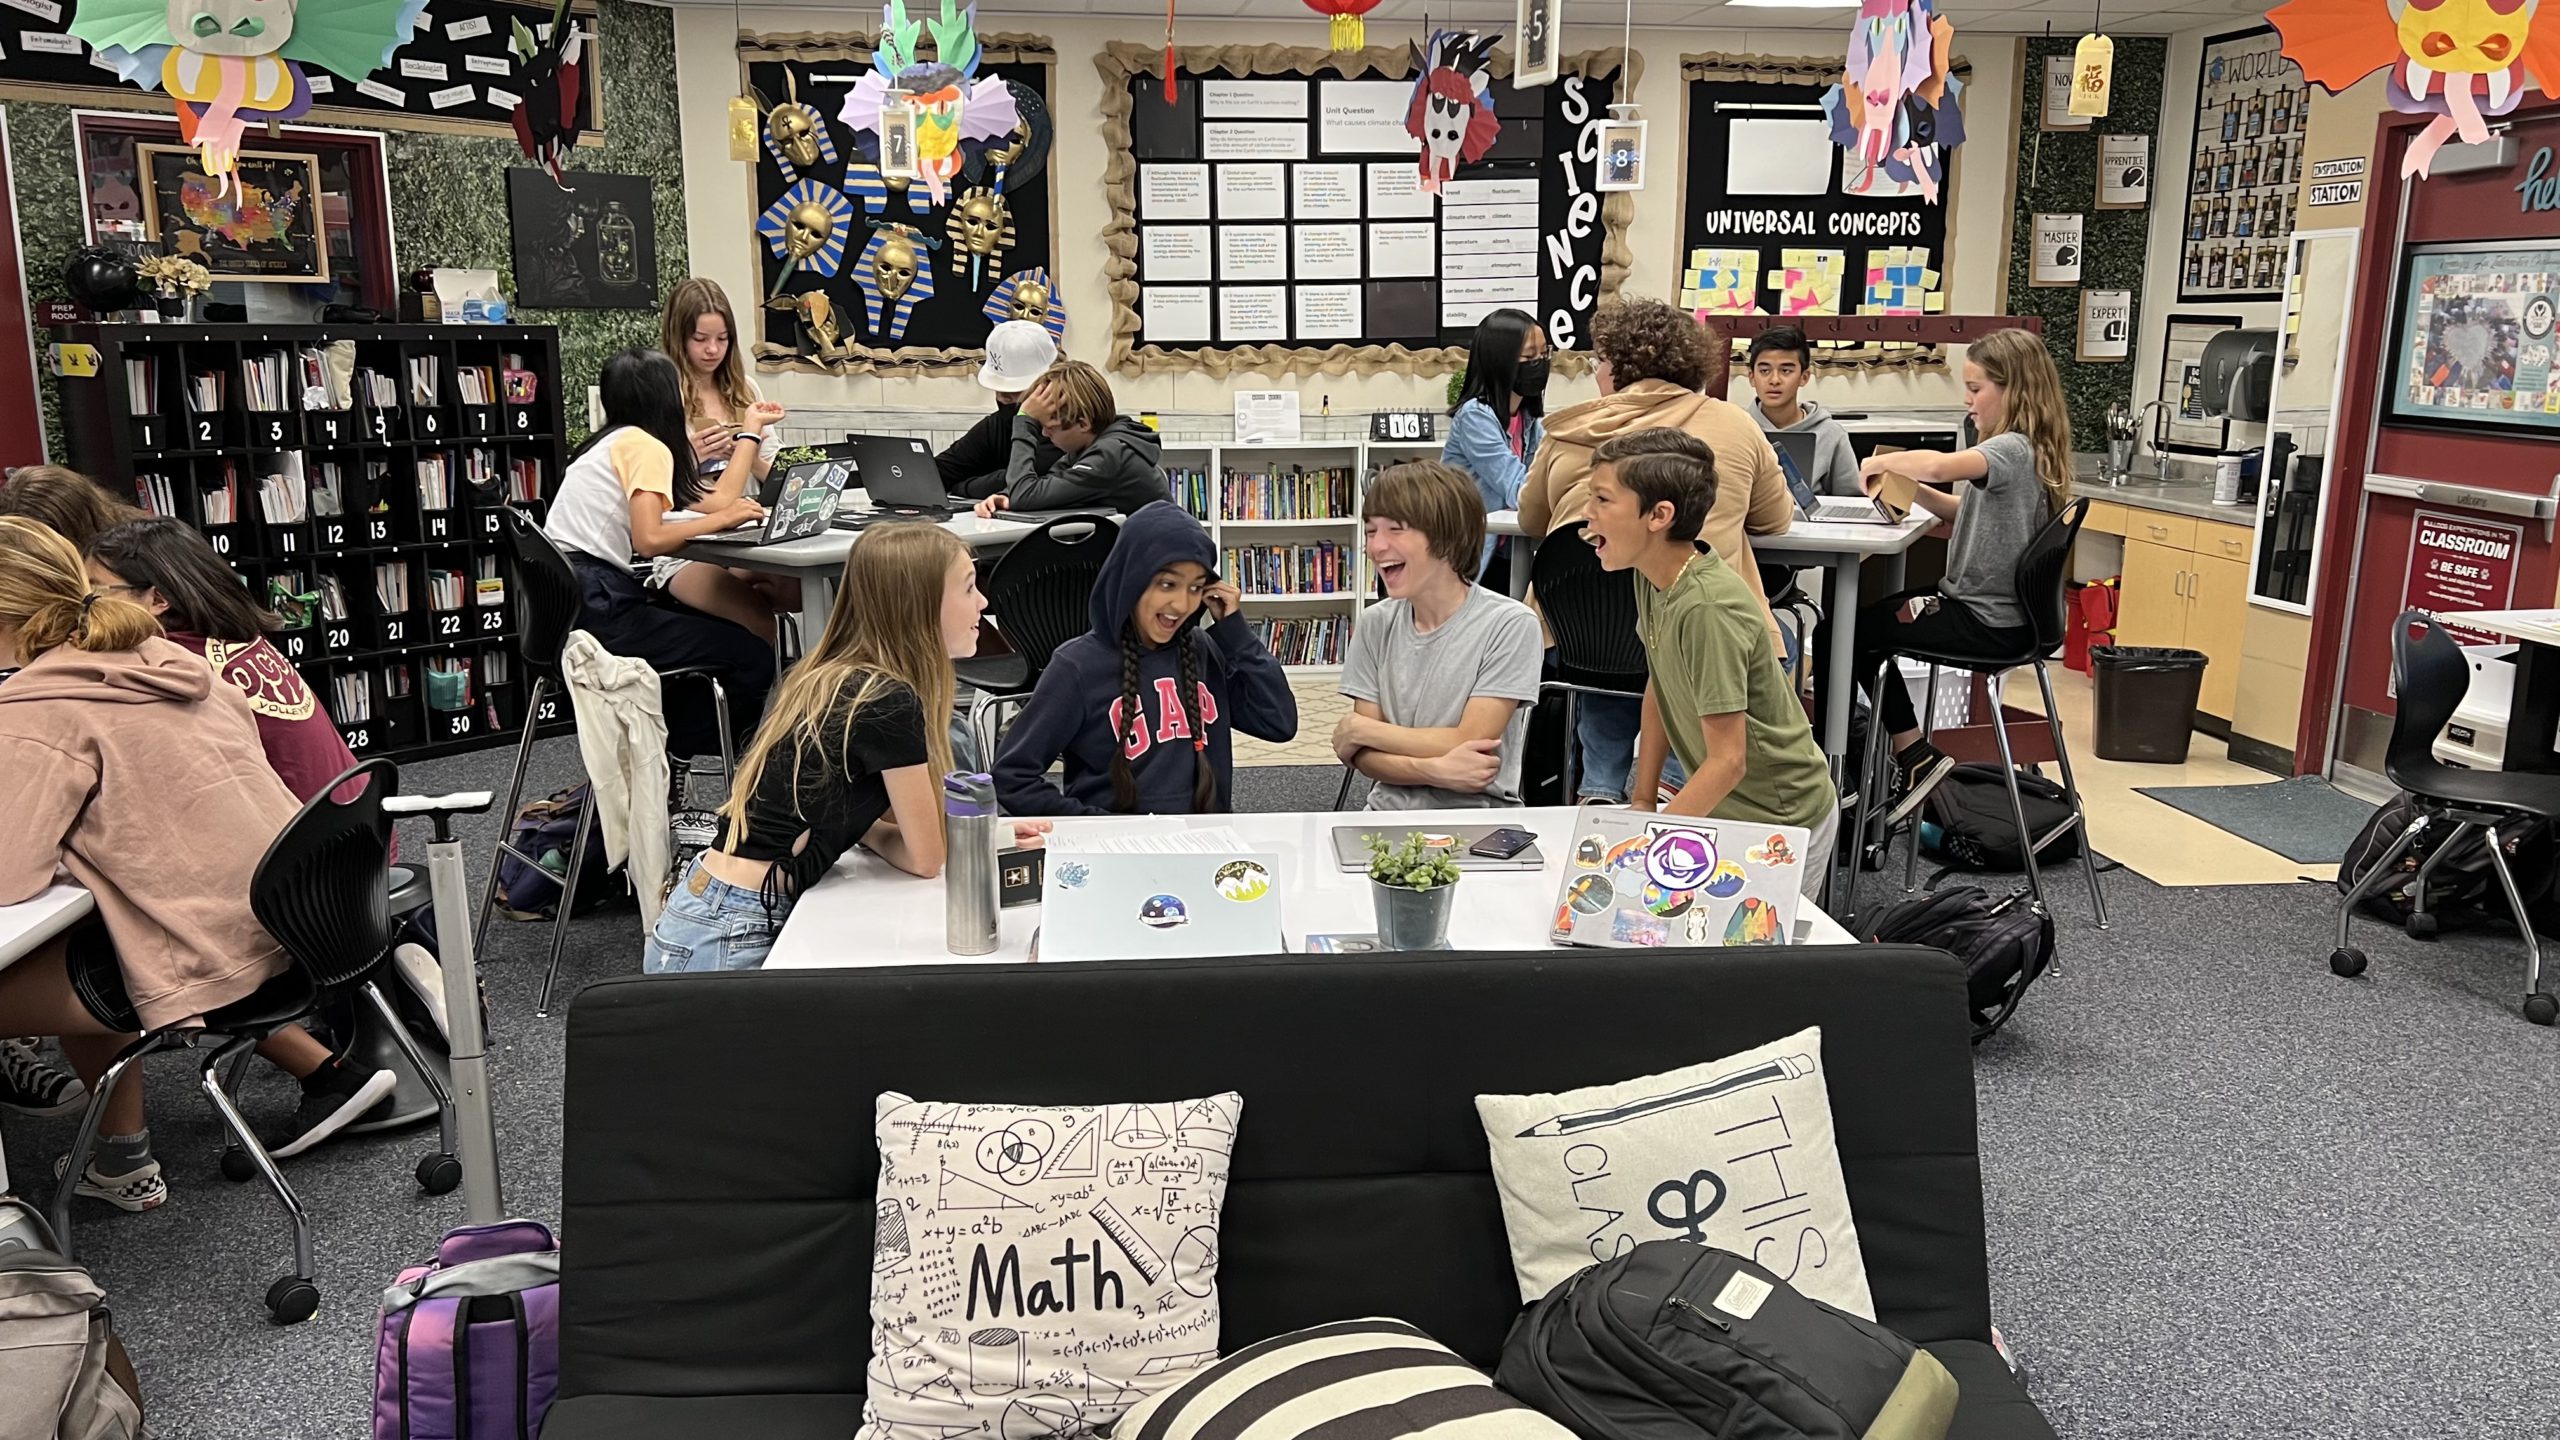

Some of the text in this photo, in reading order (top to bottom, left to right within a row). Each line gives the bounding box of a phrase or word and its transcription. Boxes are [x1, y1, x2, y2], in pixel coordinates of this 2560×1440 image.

[1533, 10, 1543, 41] 5
[893, 135, 903, 153] 7
[1616, 149, 1628, 168] 8
[2104, 155, 2144, 166] APPRENTICE
[2314, 160, 2363, 176] INSPIRATION
[2128, 166, 2145, 188] 2
[2311, 184, 2360, 203] STATION
[2044, 231, 2078, 243] MASTER
[2066, 245, 2078, 266] 3
[51, 304, 75, 312] PREP
[51, 312, 77, 320] ROOM
[2092, 307, 2127, 319] EXPERT!
[2111, 320, 2125, 342] 4
[427, 414, 437, 432] 6
[517, 411, 528, 428] 8
[1379, 417, 1387, 434] MON
[144, 425, 151, 446] 1
[199, 421, 212, 441] 2
[270, 421, 283, 440] 3
[326, 420, 337, 439] 4
[828, 468, 846, 488] SB
[370, 521, 387, 539] 13
[432, 517, 446, 536] 14
[485, 514, 500, 532] 15
[212, 534, 230, 554] 10
[283, 532, 296, 552] 11
[328, 525, 344, 544] 12
[2420, 530, 2510, 560] CLASSROOM
[2440, 562, 2479, 578] BE SAFE
[441, 615, 460, 634] 22
[483, 612, 502, 630] 23
[328, 629, 350, 648] 20
[388, 622, 404, 640] 21
[288, 637, 304, 657] 19
[451, 716, 470, 734] 30
[1108, 677, 1219, 760] GAP
[347, 730, 369, 749] 28
[926, 1209, 936, 1220] A
[966, 1237, 1124, 1321] Math
[1134, 1304, 1145, 1319] 3
